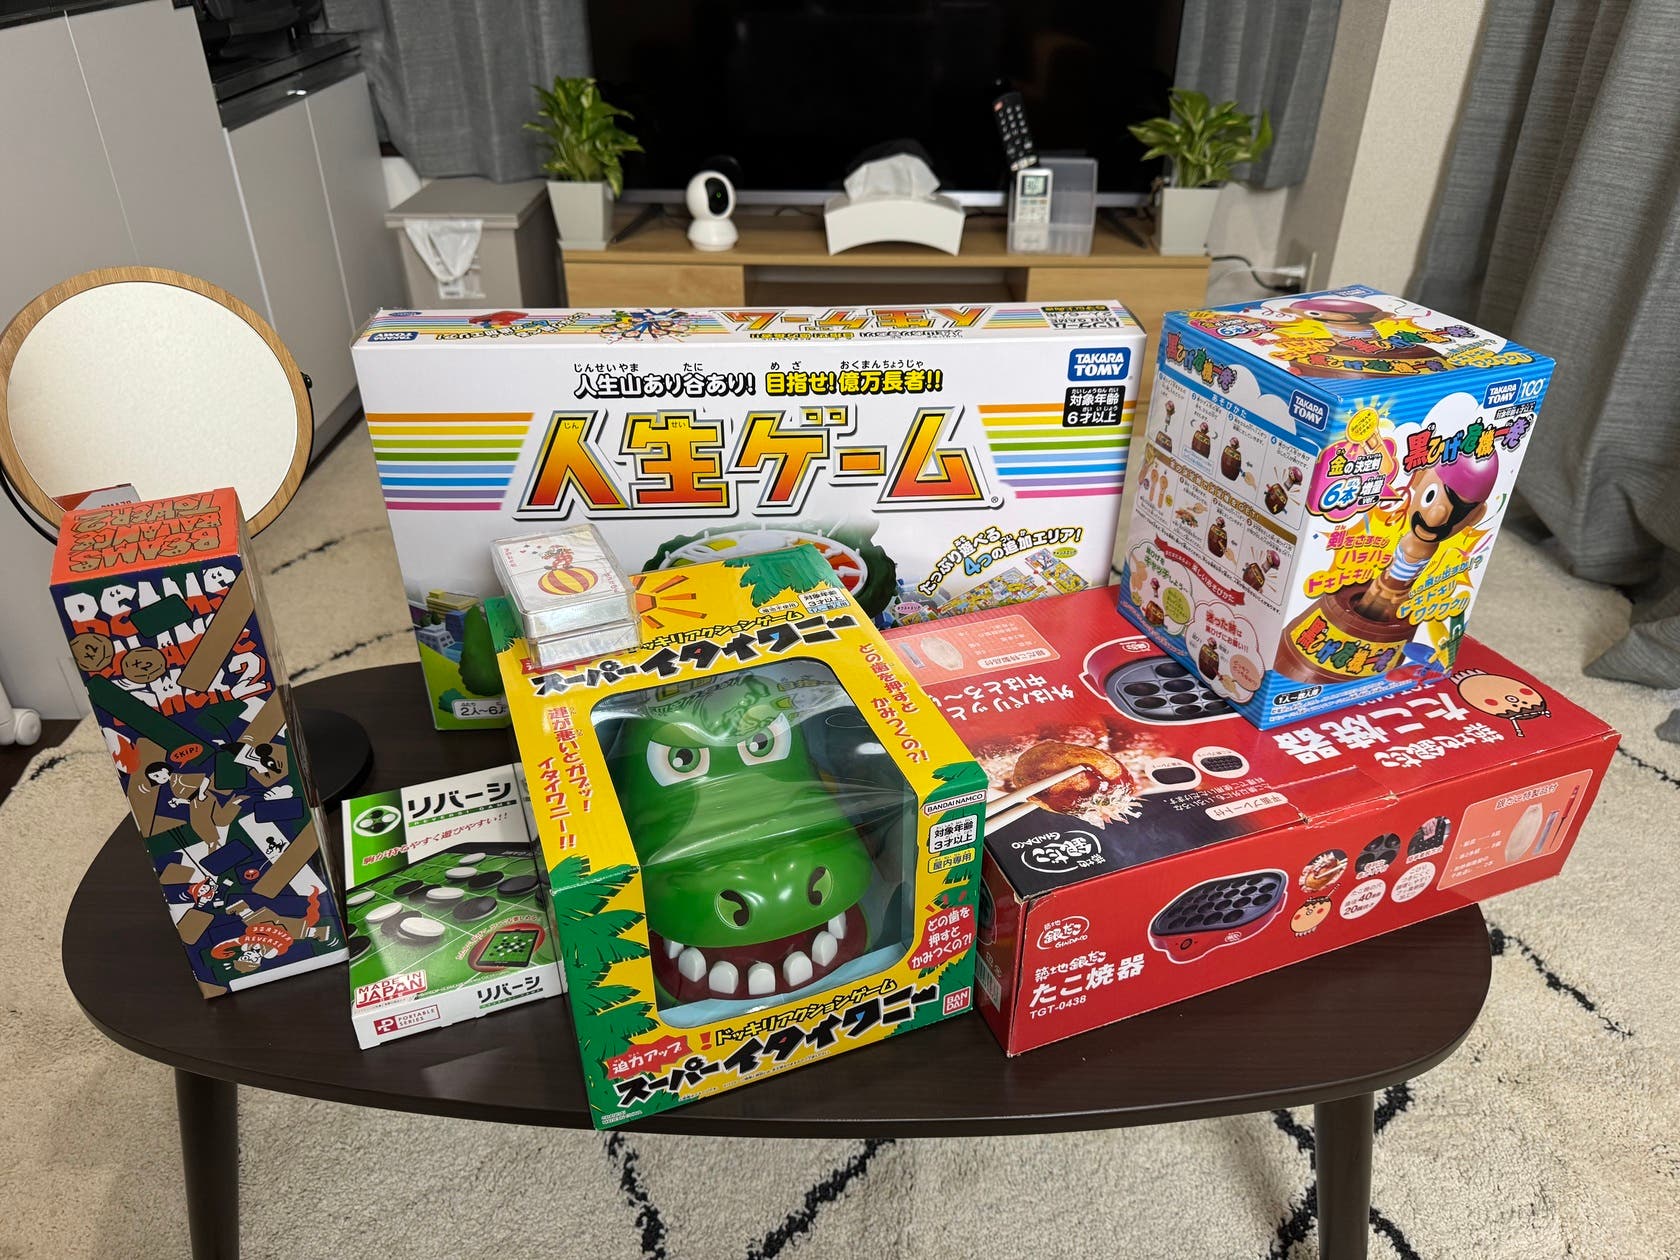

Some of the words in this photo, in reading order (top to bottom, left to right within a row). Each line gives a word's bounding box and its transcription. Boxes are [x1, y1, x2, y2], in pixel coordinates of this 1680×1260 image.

[1074, 364, 1124, 376] TOMY
[1076, 353, 1124, 364] TAKARA
[574, 372, 756, 399] 人生山あり谷あり!
[1489, 384, 1517, 396] TAKARA
[1070, 393, 1119, 407] 対象年齢
[1211, 393, 1249, 419] あそびかた
[1293, 395, 1324, 417] TAKARA
[1488, 392, 1516, 405] TOMY
[1067, 411, 1117, 424] 6才以上
[1292, 405, 1323, 426] TOMY
[516, 404, 992, 514] 人生ゲーム
[69, 529, 221, 573] BEAMS
[963, 527, 1084, 576] 4つの追加エリア!
[1326, 530, 1390, 551] 剣をさすたび
[918, 526, 1001, 596] たっぷり遊べる
[1341, 550, 1393, 567] ハラハラ
[1306, 568, 1371, 594] ドキドキ!!
[1414, 597, 1468, 622] ワクワク!!
[630, 611, 804, 654] ッキリアクションゲーム
[946, 684, 1074, 721] 外はパリッと
[1274, 691, 1470, 765] たこ焼器
[172, 745, 201, 760] SKIP!
[1373, 722, 1504, 768] 築地銀だこ
[408, 782, 511, 819] リバーシ
[537, 756, 575, 850] イタイワニー!!
[927, 800, 955, 813] BANDAI
[955, 793, 983, 806] NAMCO
[1215, 795, 1280, 818] 平面プレート付
[934, 820, 974, 839] 対象年齢
[934, 833, 973, 850] 3才以上
[1010, 831, 1060, 850] GINDACO
[933, 852, 972, 870] 屋内専用
[926, 906, 971, 932] どの歯を
[928, 925, 961, 949] 押すと
[1034, 950, 1107, 982] 築地銀だこ
[358, 976, 399, 994] MADE
[407, 971, 422, 981] IN
[358, 978, 422, 1004] JAPAN
[477, 976, 540, 1003] リバーシ
[1029, 952, 1145, 1008] たこ焼器
[946, 1000, 963, 1012] DAI
[947, 991, 968, 1004] BAN
[1030, 994, 1087, 1019] TGT-0438
[398, 1008, 435, 1021] PORTABLE
[399, 1016, 424, 1026] SERIES
[715, 978, 897, 1047] ドッキリアクションゲーム
[611, 1041, 683, 1075] 迫力アップ
[616, 984, 939, 1108] スーパーイタイワニー
